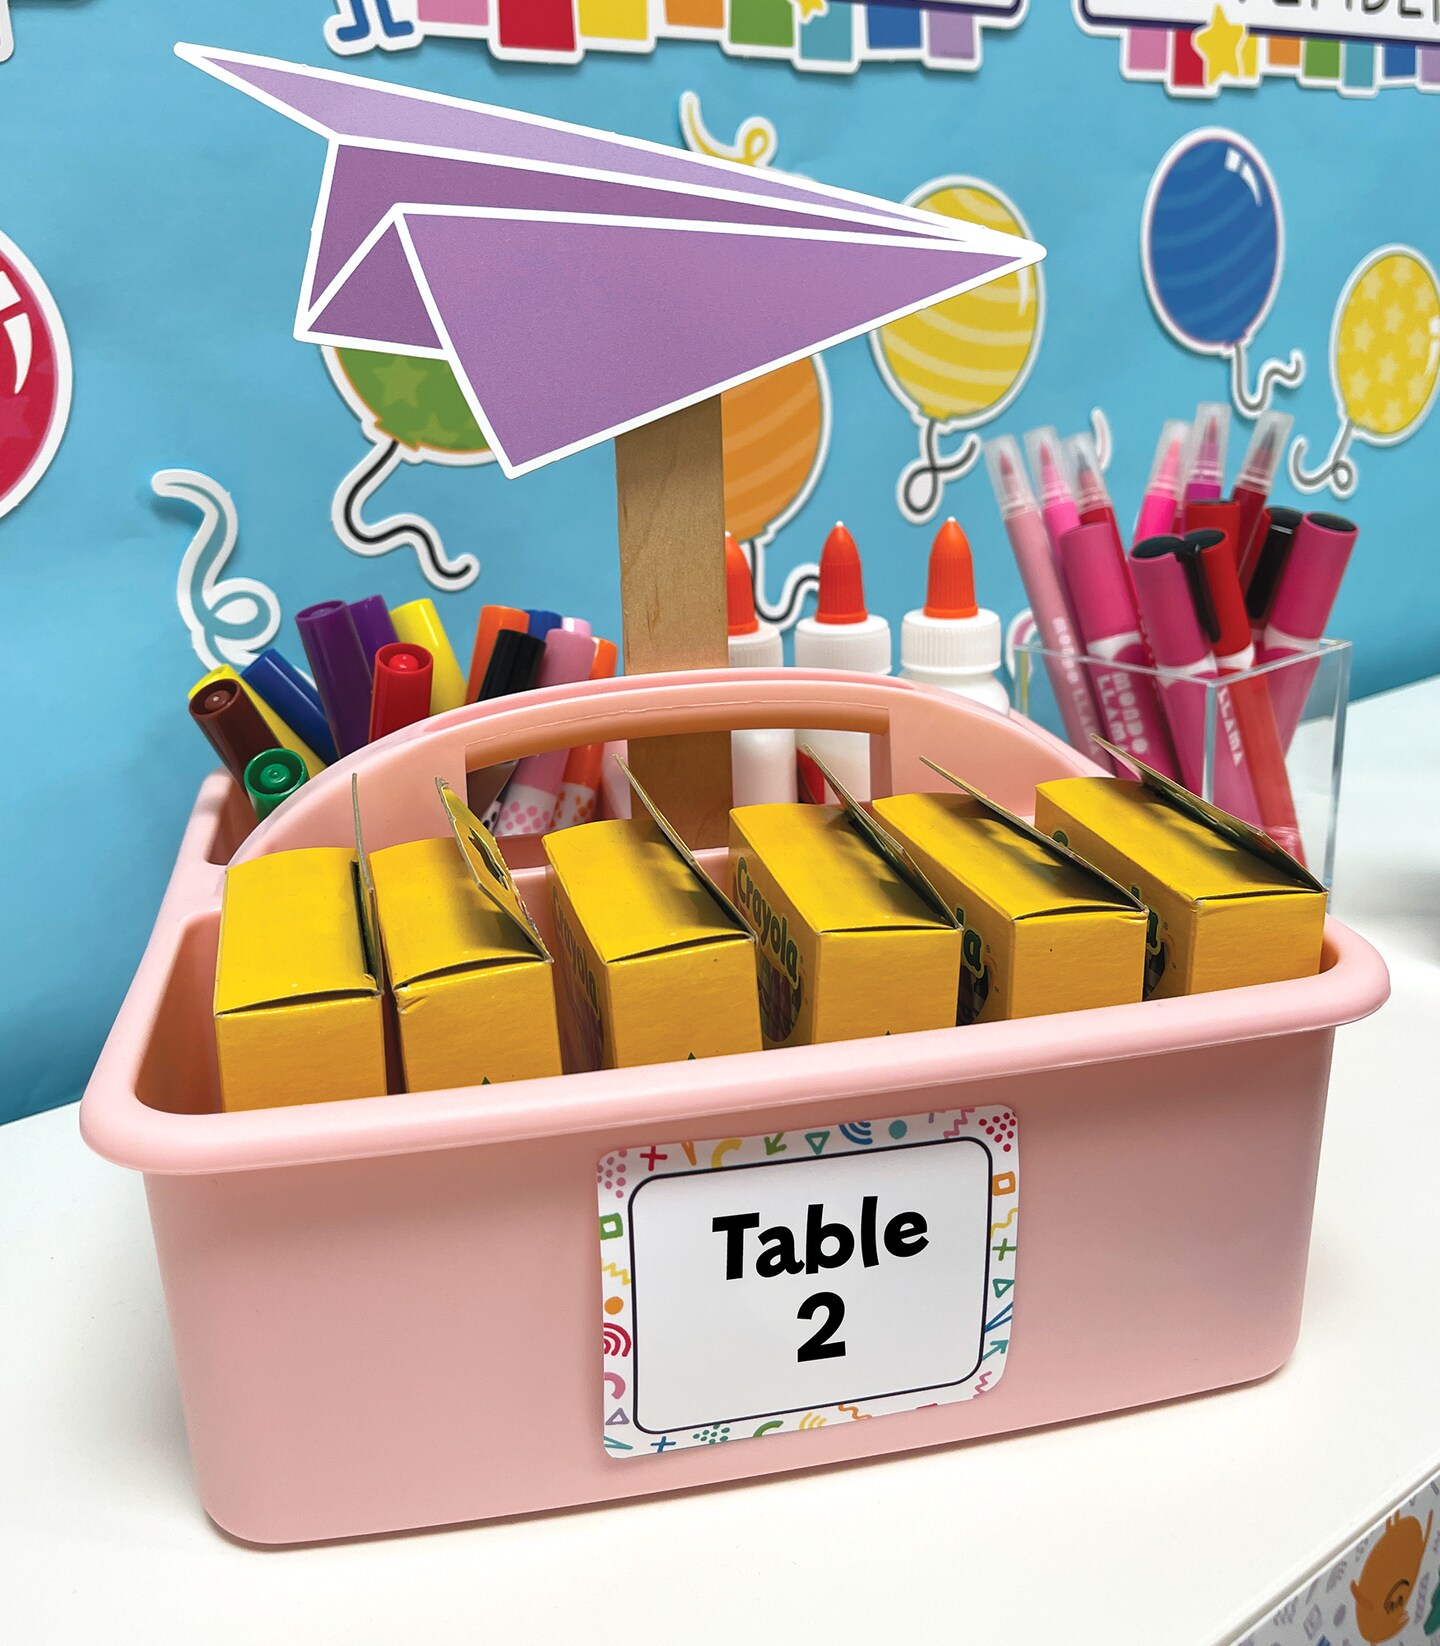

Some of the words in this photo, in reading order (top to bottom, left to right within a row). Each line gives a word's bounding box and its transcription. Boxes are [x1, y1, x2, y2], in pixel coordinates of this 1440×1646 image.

[737, 855, 799, 987] Crayola
[711, 1195, 930, 1281] Table
[796, 1291, 847, 1363] 2
